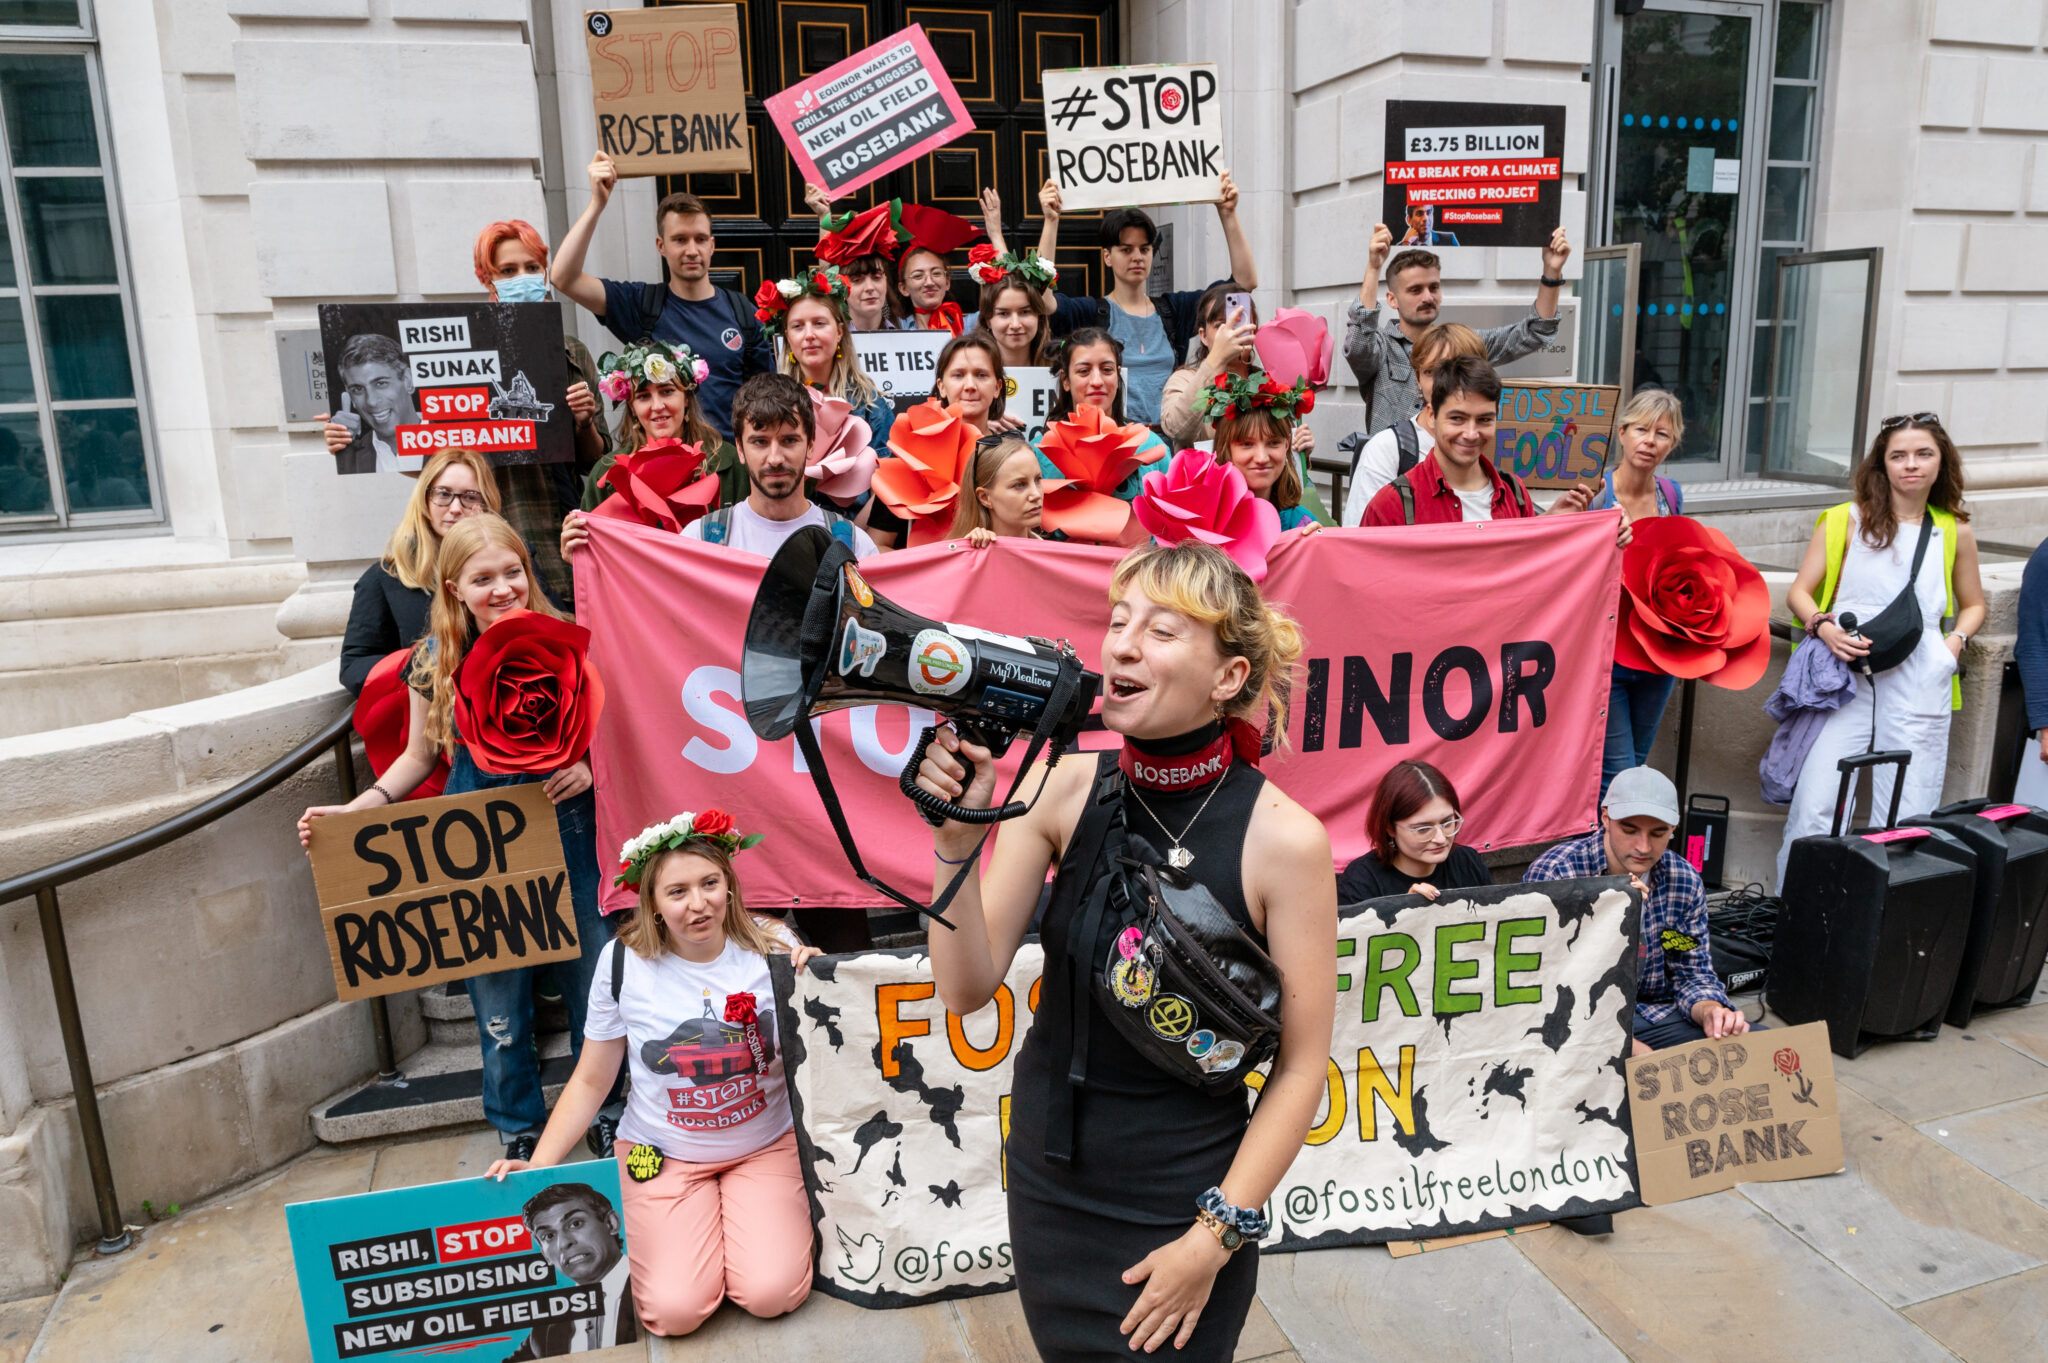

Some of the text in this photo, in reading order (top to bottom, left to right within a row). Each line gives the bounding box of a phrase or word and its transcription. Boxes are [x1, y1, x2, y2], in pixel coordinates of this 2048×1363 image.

[595, 28, 738, 102] STOP
[818, 45, 912, 100] EQUINOR WANTS TO
[795, 58, 920, 133] DRILL THE UK'S BIGGEST
[807, 77, 929, 152] NEW OIL FIELD
[1051, 69, 1217, 132] #STOP
[599, 112, 743, 156] ROSEBANK
[826, 103, 947, 179] ROSEBANK
[1410, 134, 1540, 153] £3.75 BILLION
[1055, 139, 1221, 190] ROSEBANK
[1389, 163, 1558, 179] TAX BREAK FOR A CLIMATE
[1409, 186, 1537, 202] WRECKING PROJECT
[1443, 210, 1502, 222] #StopRosebank
[405, 323, 465, 345] RISHI
[311, 369, 326, 379] De
[313, 380, 327, 390] En
[415, 357, 497, 379] SUNAK
[858, 350, 936, 373] HE TIES
[424, 394, 486, 415] STOP
[1497, 388, 1605, 423] FOSSIL
[401, 425, 532, 450] ROSEBANK!
[1494, 428, 1610, 480] FOOLS
[1134, 754, 1223, 786] ROSEBANK
[353, 800, 527, 897] STOP
[334, 871, 578, 988] ROSEBANK
[745, 1023, 768, 1075] ROSEBANK
[1633, 1042, 1748, 1101] STOP
[676, 1078, 753, 1107] #STOP
[1661, 1083, 1774, 1141] ROSE
[1685, 1119, 1813, 1179] BANK
[1284, 1147, 1619, 1225] @fossilfreelondon
[337, 1223, 525, 1273] RISHI, STOP
[894, 1240, 1013, 1284] @foss
[351, 1258, 551, 1309] SUBSIDISING
[341, 1290, 599, 1351] NEW OIL FIELDS!
